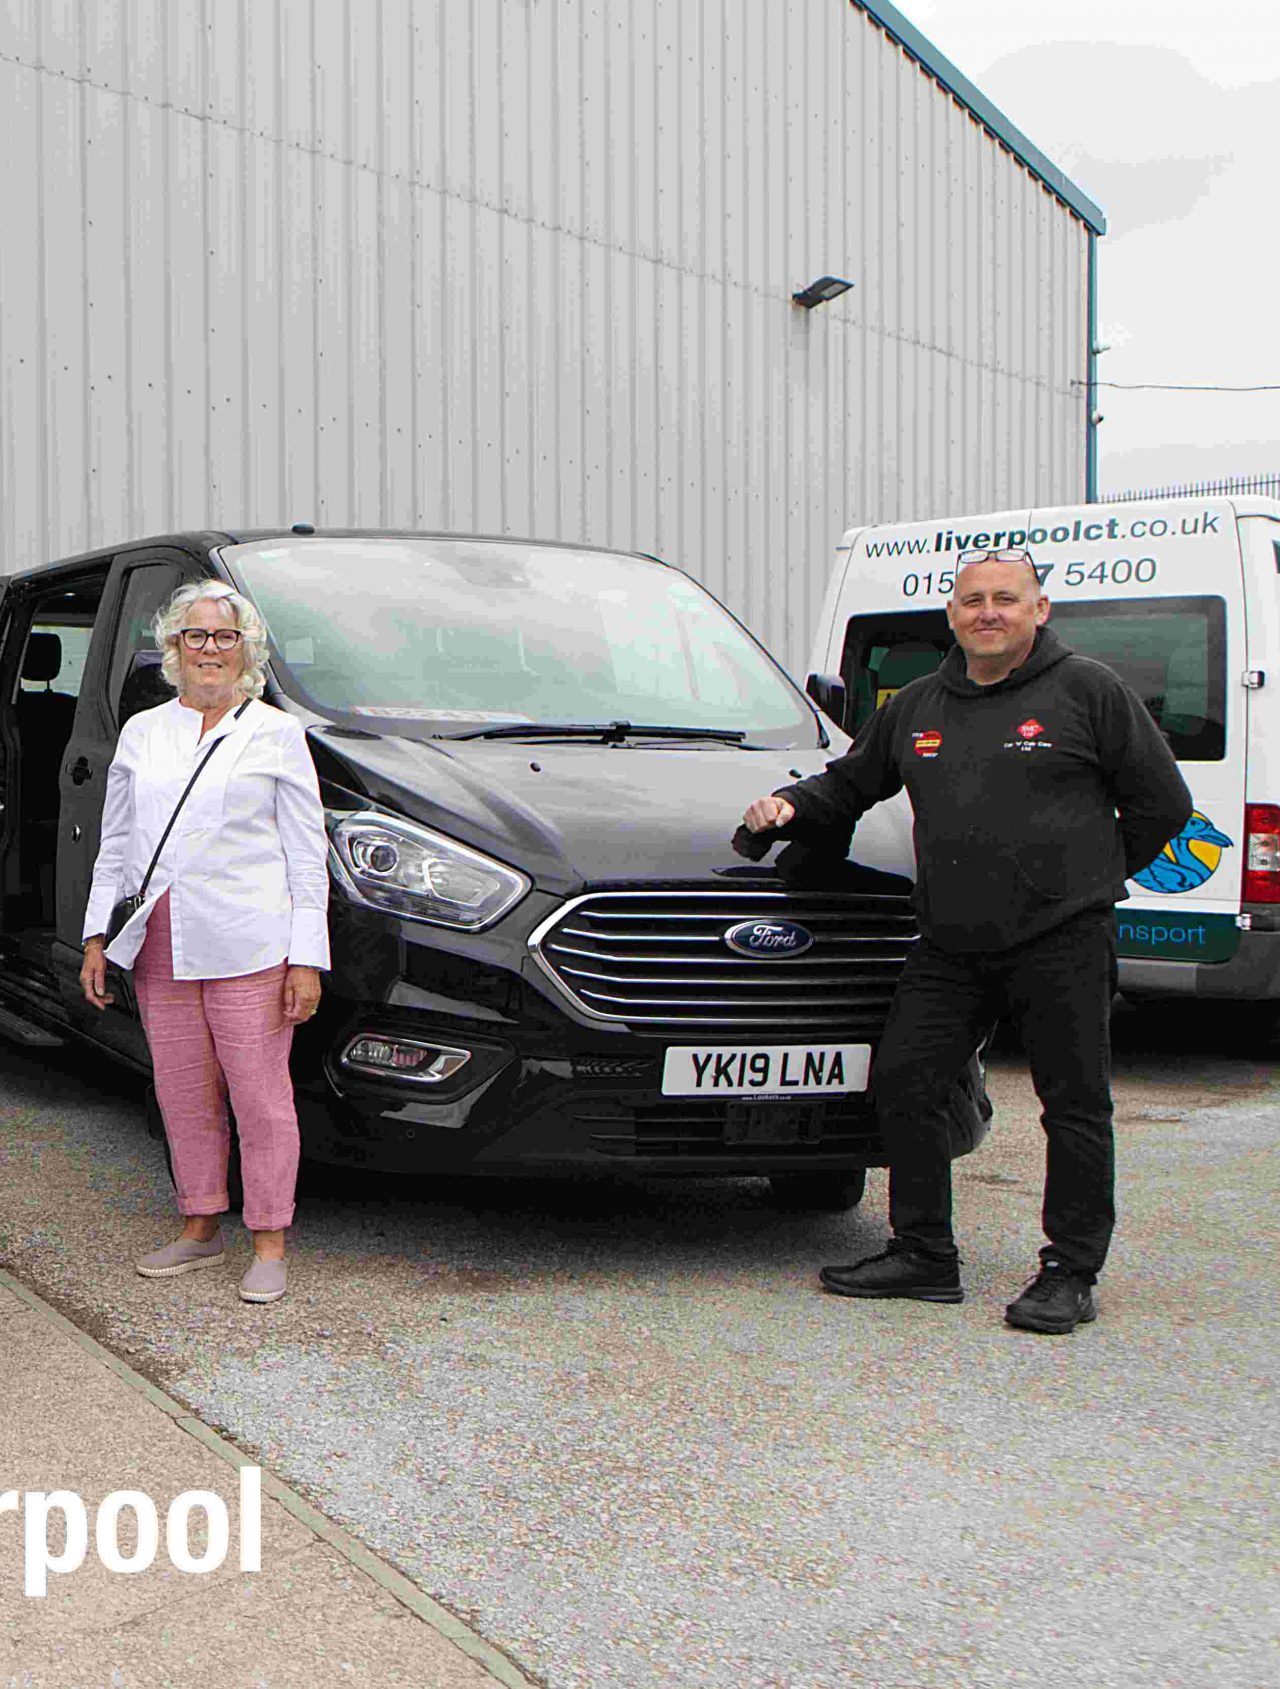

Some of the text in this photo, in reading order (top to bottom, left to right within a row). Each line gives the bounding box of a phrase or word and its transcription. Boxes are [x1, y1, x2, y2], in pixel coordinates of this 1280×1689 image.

[866, 511, 1220, 558] www.liverpoolct.co.uk
[902, 571, 954, 597] 015
[1064, 557, 1157, 586] 5400
[749, 924, 796, 948] Ford
[1119, 924, 1205, 945] nsport
[692, 1051, 845, 1088] YK19 LNA
